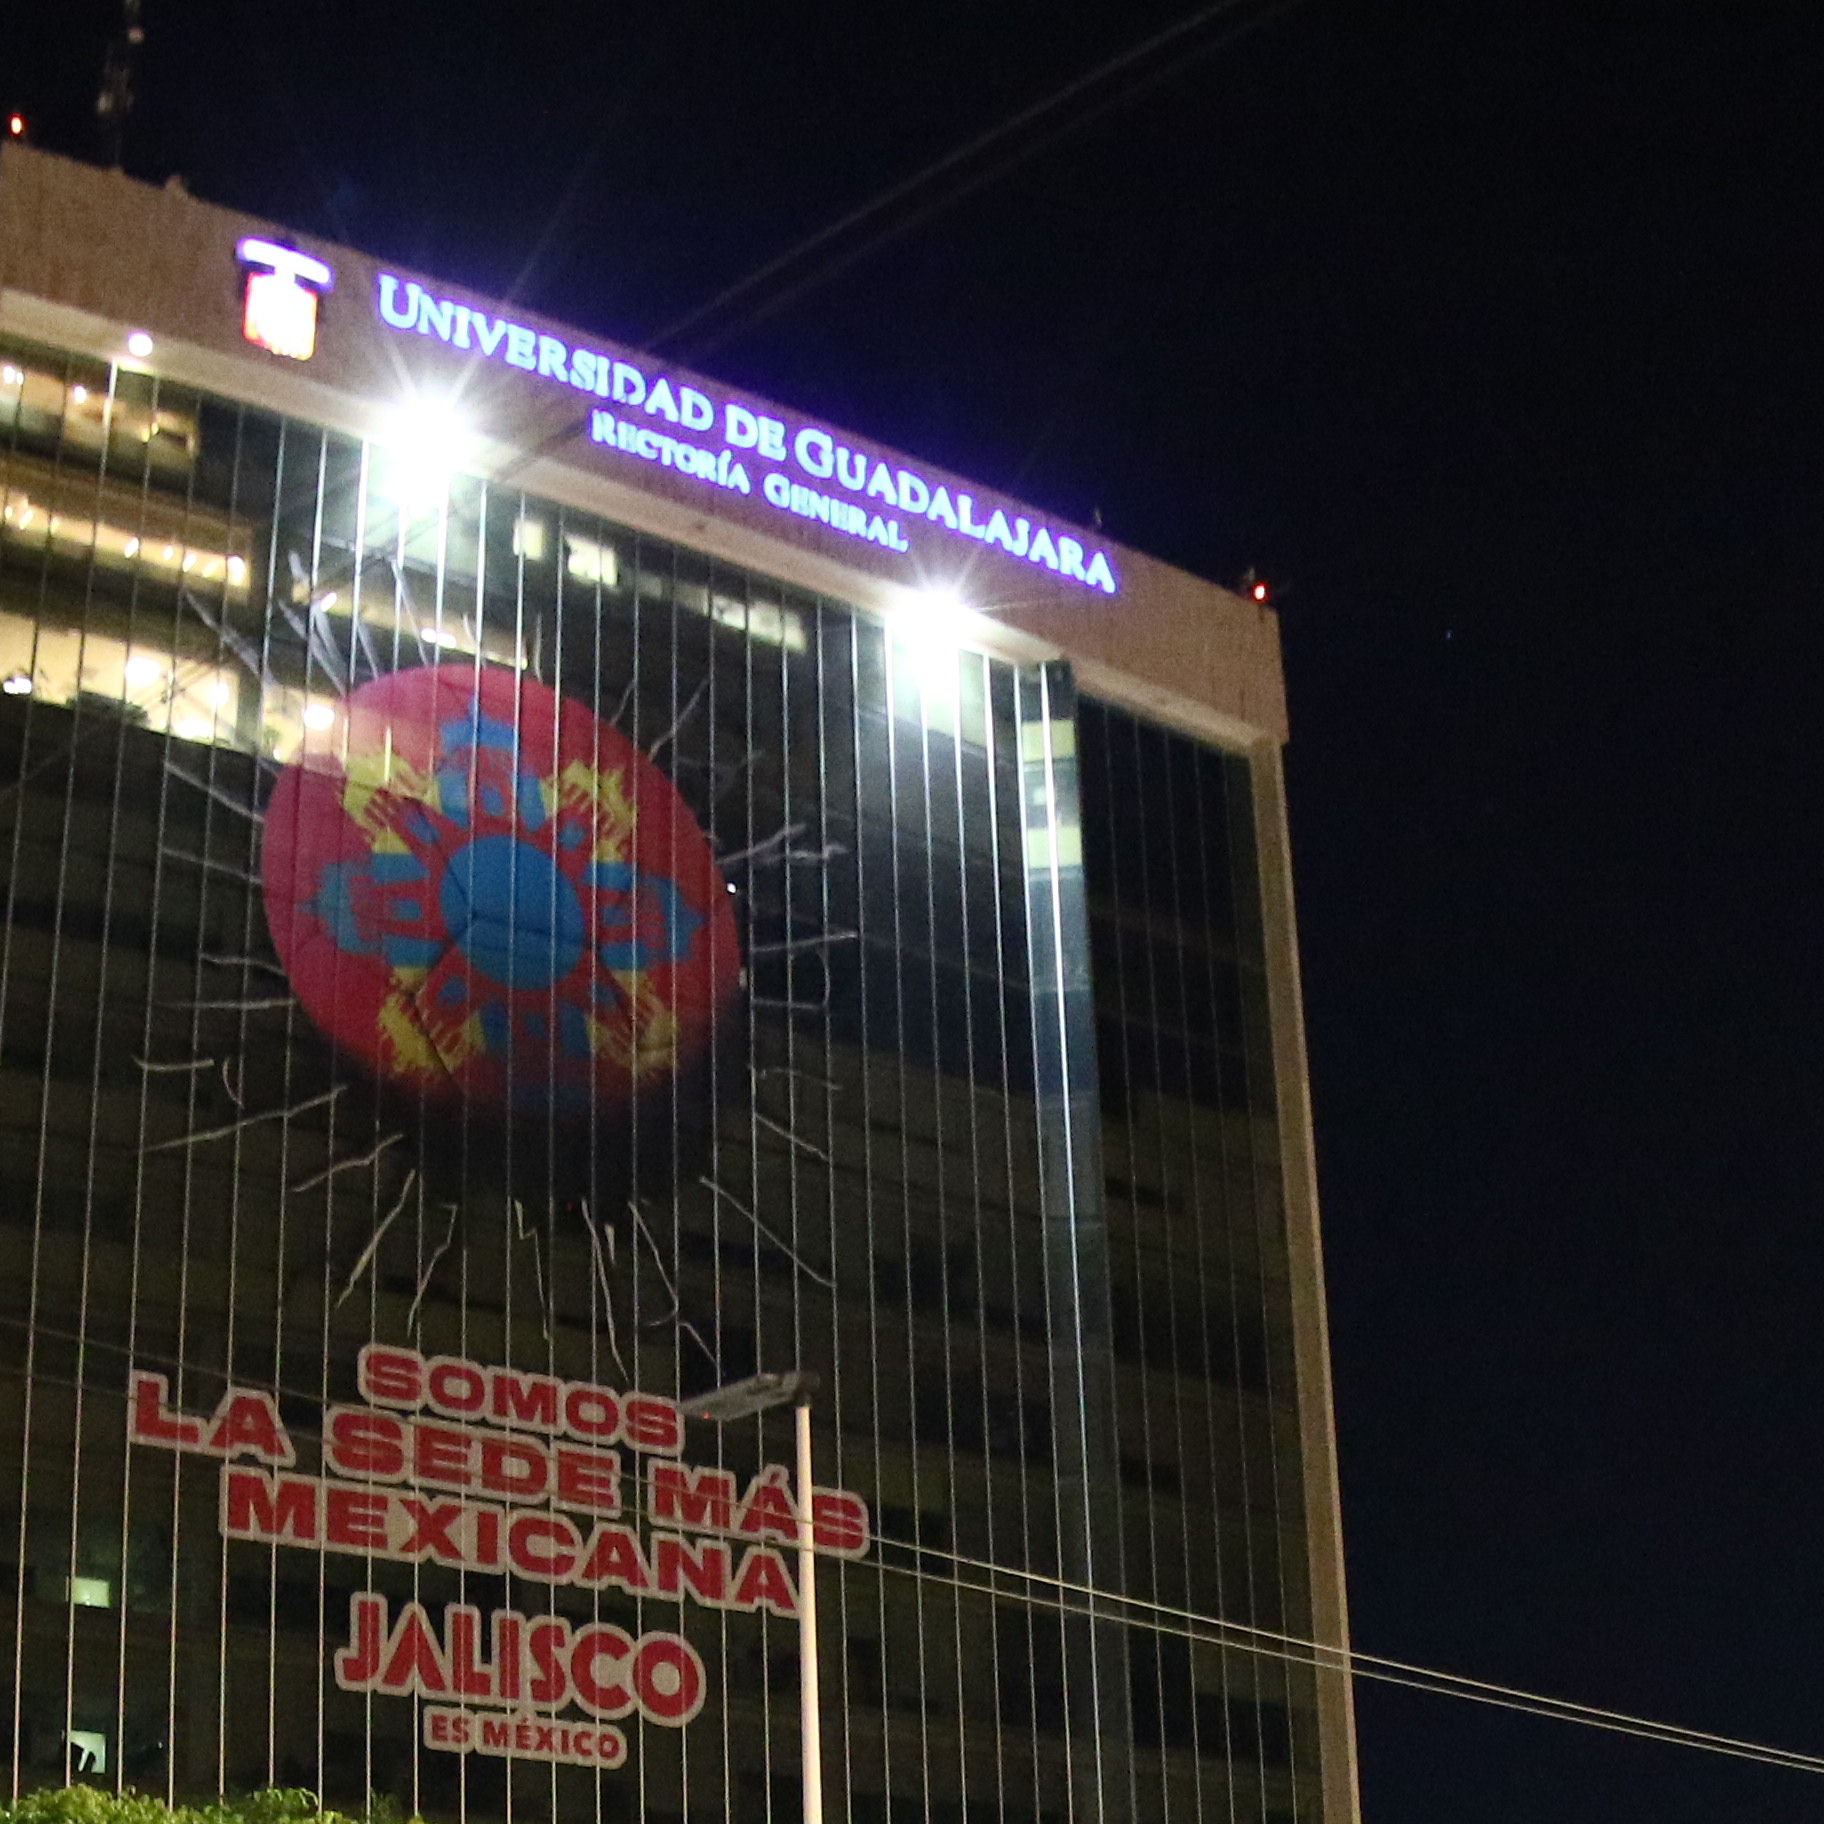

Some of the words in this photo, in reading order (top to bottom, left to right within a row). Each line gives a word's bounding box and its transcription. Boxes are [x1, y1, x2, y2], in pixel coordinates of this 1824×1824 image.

[377, 273, 715, 432] UNIVERSIDAD
[724, 403, 785, 463] DE
[795, 428, 1117, 594] GUADALAJARA
[592, 409, 750, 496] RECTORÍA
[766, 472, 909, 553] GENERAL
[135, 1377, 288, 1460] LA
[330, 1411, 617, 1511] SEDE
[654, 1463, 866, 1552] MÁS
[362, 1350, 681, 1448] SOMOS
[226, 1474, 800, 1610] MEXICANA
[342, 1600, 699, 1721] JALISCO
[431, 1713, 472, 1744] ES
[482, 1716, 621, 1761] MÉXICO
